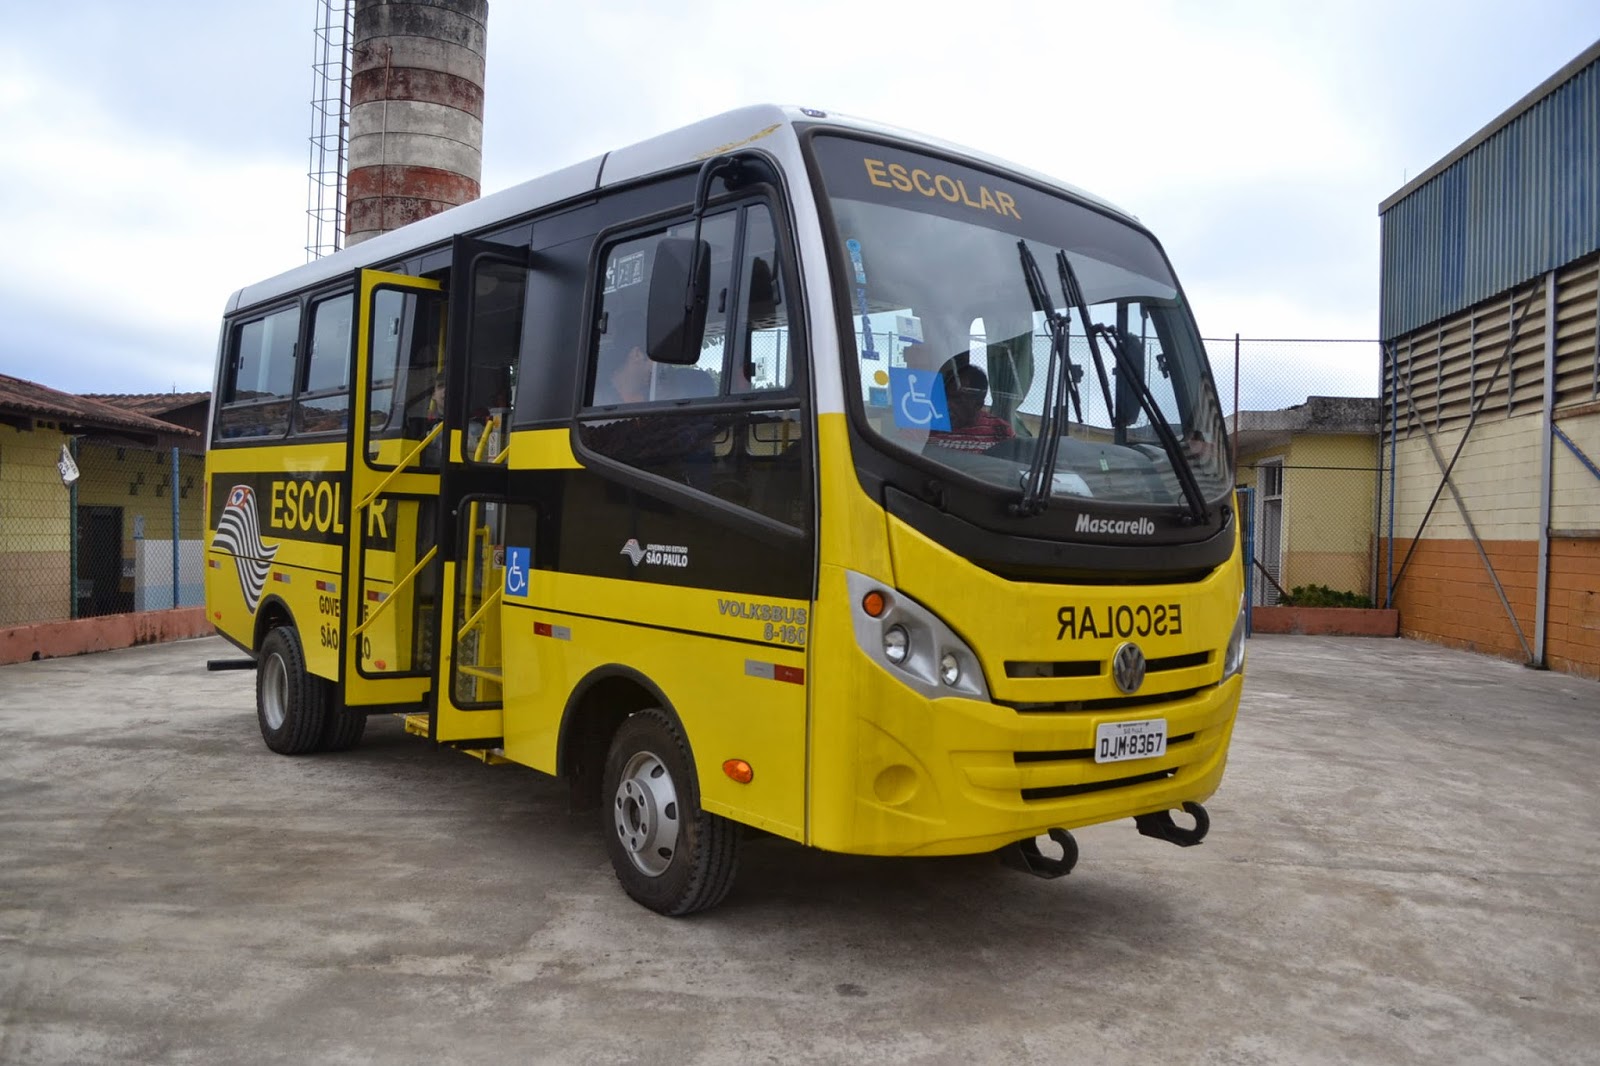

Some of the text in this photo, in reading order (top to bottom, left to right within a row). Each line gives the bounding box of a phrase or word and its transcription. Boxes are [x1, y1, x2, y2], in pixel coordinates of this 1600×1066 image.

[864, 158, 1022, 220] ESCOLAR
[270, 480, 388, 538] ESCOLR
[1075, 513, 1155, 535] Mascarello
[646, 550, 688, 567] SÃO PAULO
[717, 599, 807, 625] VOLKSBUS
[320, 622, 338, 650] SÃO
[763, 622, 806, 645] 8-160
